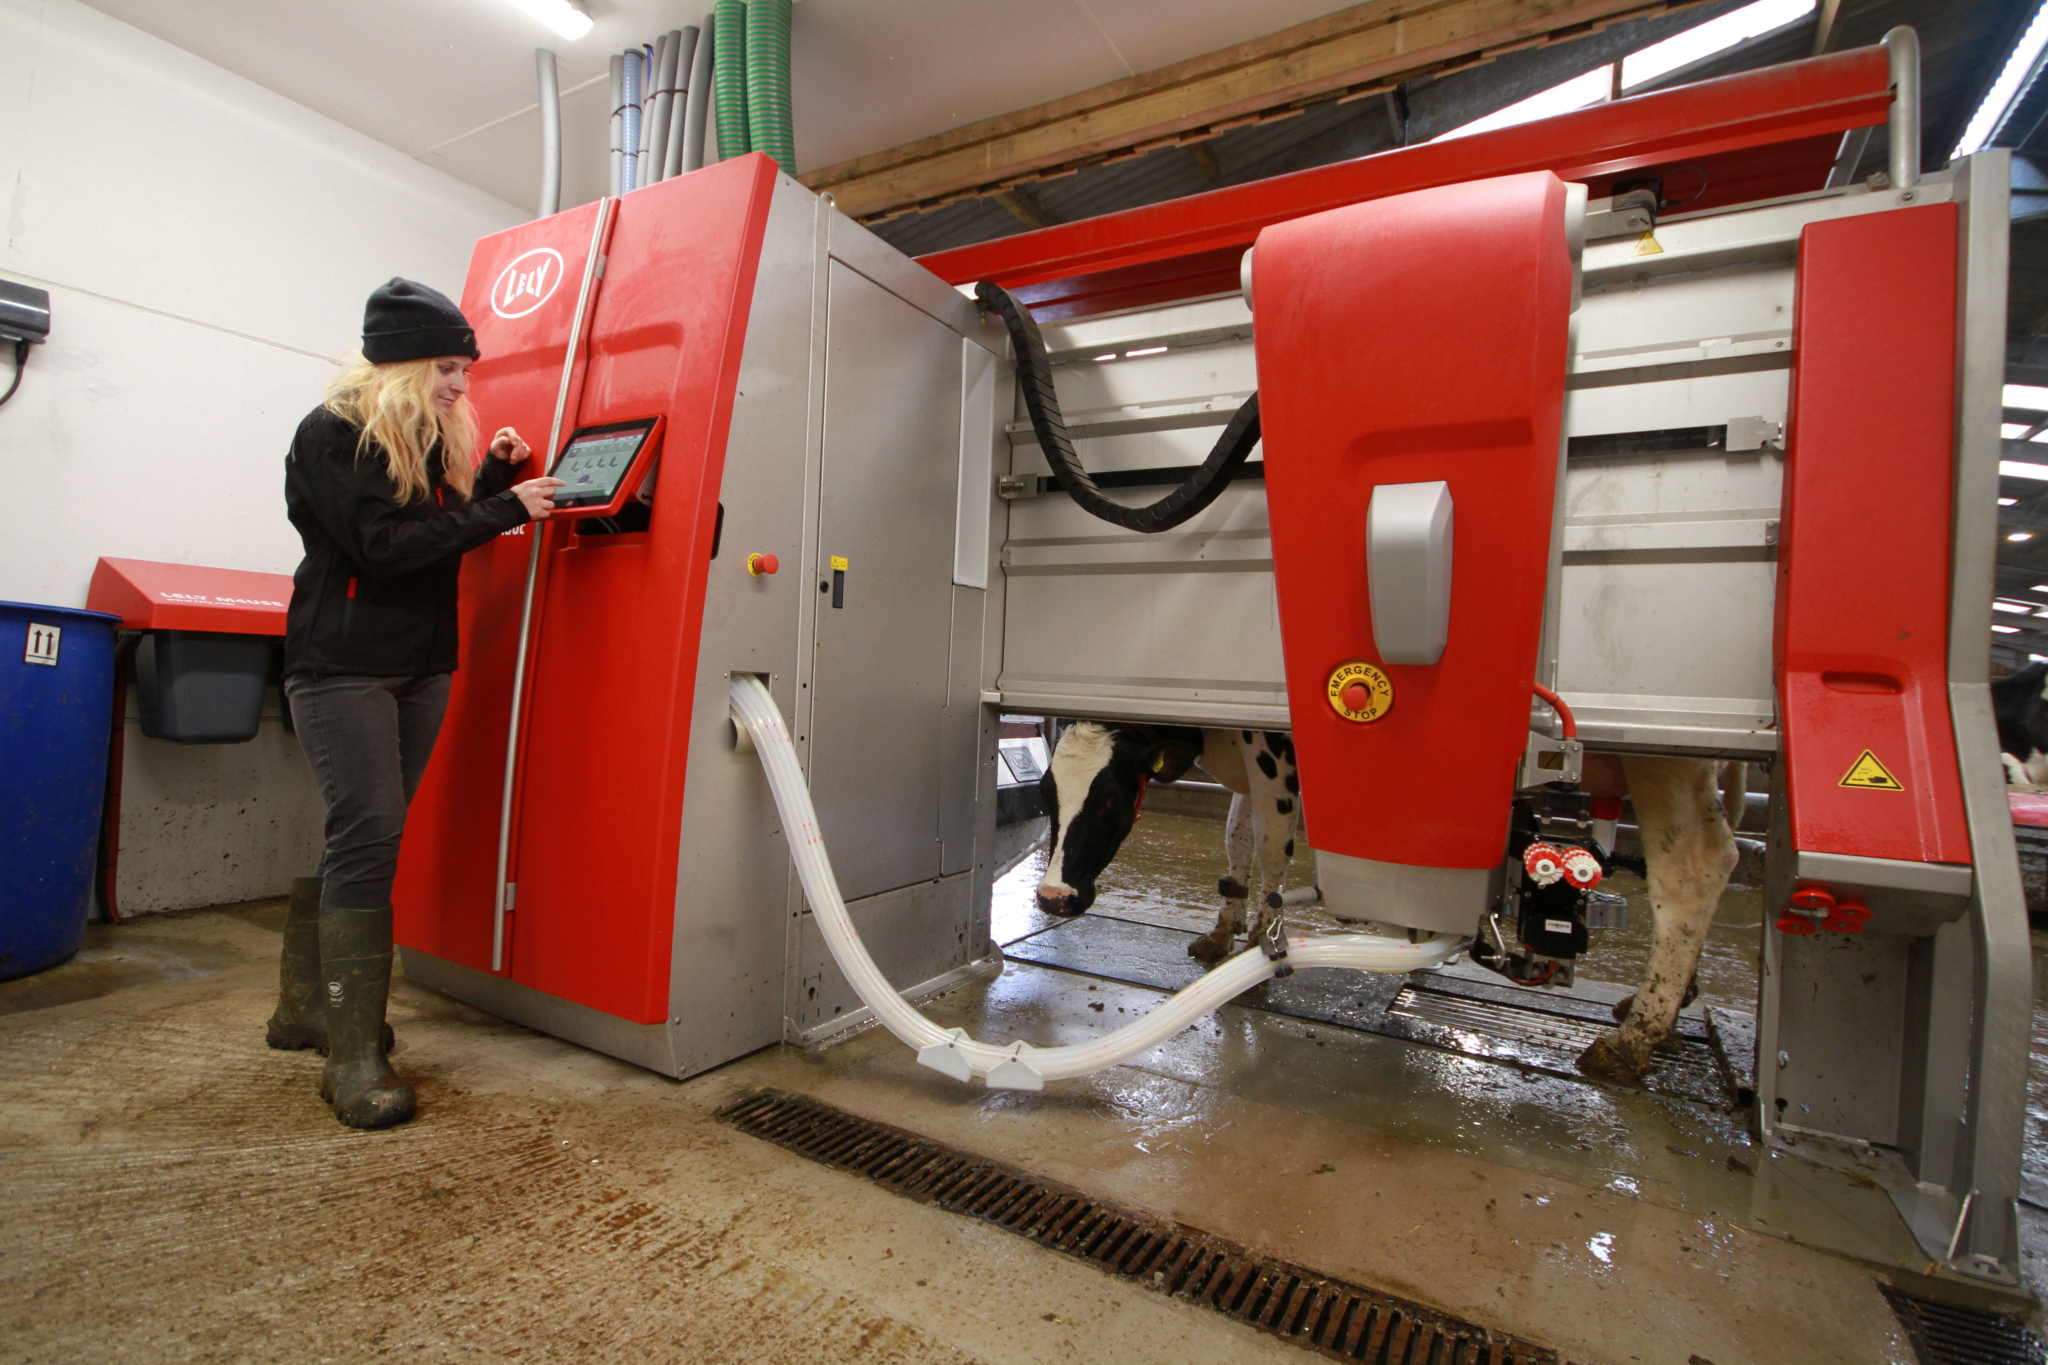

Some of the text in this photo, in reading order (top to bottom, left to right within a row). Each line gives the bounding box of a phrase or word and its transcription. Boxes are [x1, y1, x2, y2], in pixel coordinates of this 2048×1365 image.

[502, 257, 552, 308] LELY
[160, 592, 207, 600] LELY
[1330, 665, 1389, 697] EMERGENCY
[1344, 707, 1378, 720] STOP
